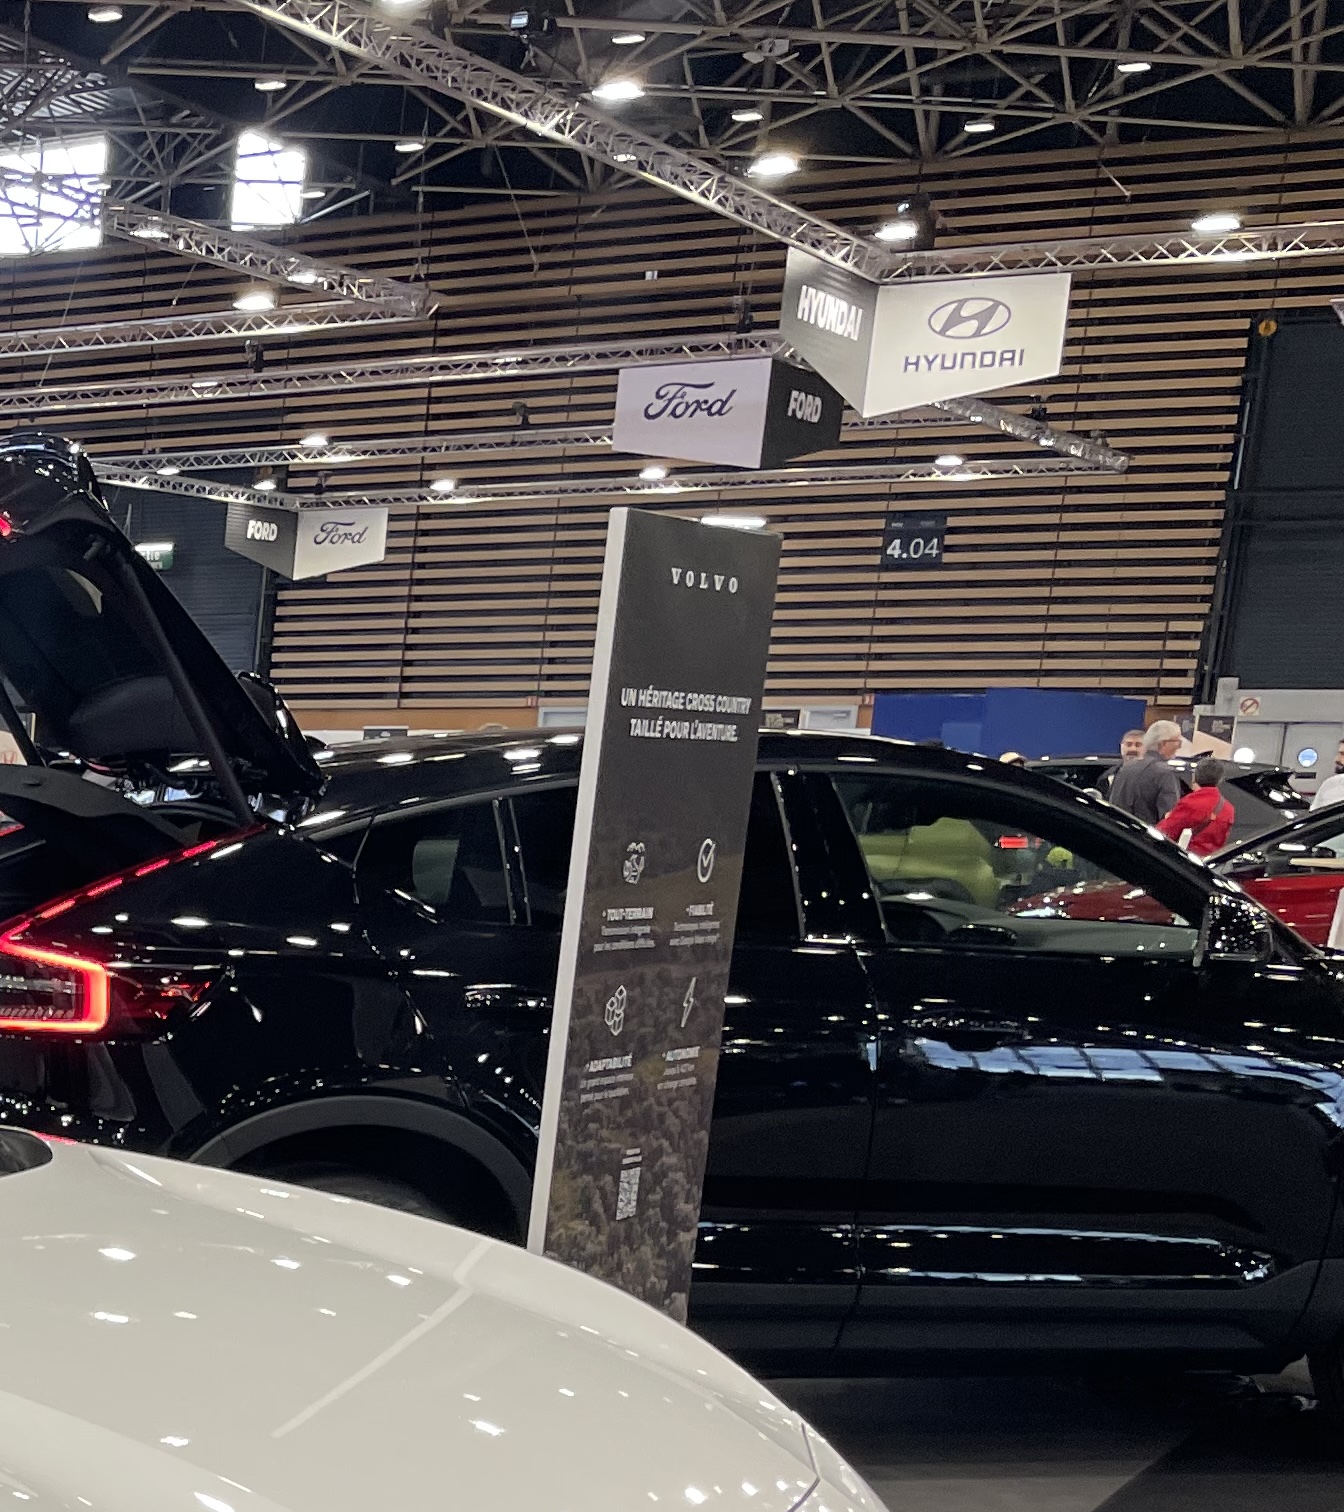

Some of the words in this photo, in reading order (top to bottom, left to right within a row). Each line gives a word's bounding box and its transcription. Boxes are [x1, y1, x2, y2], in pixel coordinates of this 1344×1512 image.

[796, 284, 864, 342] HYUNDAI
[903, 348, 1025, 374] HYUNDAI
[643, 381, 738, 421] Ford
[786, 389, 824, 424] FORD
[246, 519, 279, 542] FORD
[313, 520, 369, 546] Ford
[886, 537, 940, 559] 4.04
[670, 567, 740, 594] VOLVO
[621, 687, 638, 707] UN
[638, 685, 686, 710] HÉRITAGE
[686, 692, 716, 713] CROSS
[716, 695, 753, 715] COUNTRY
[630, 716, 663, 739] TAILLÉ
[663, 720, 690, 740] POUR
